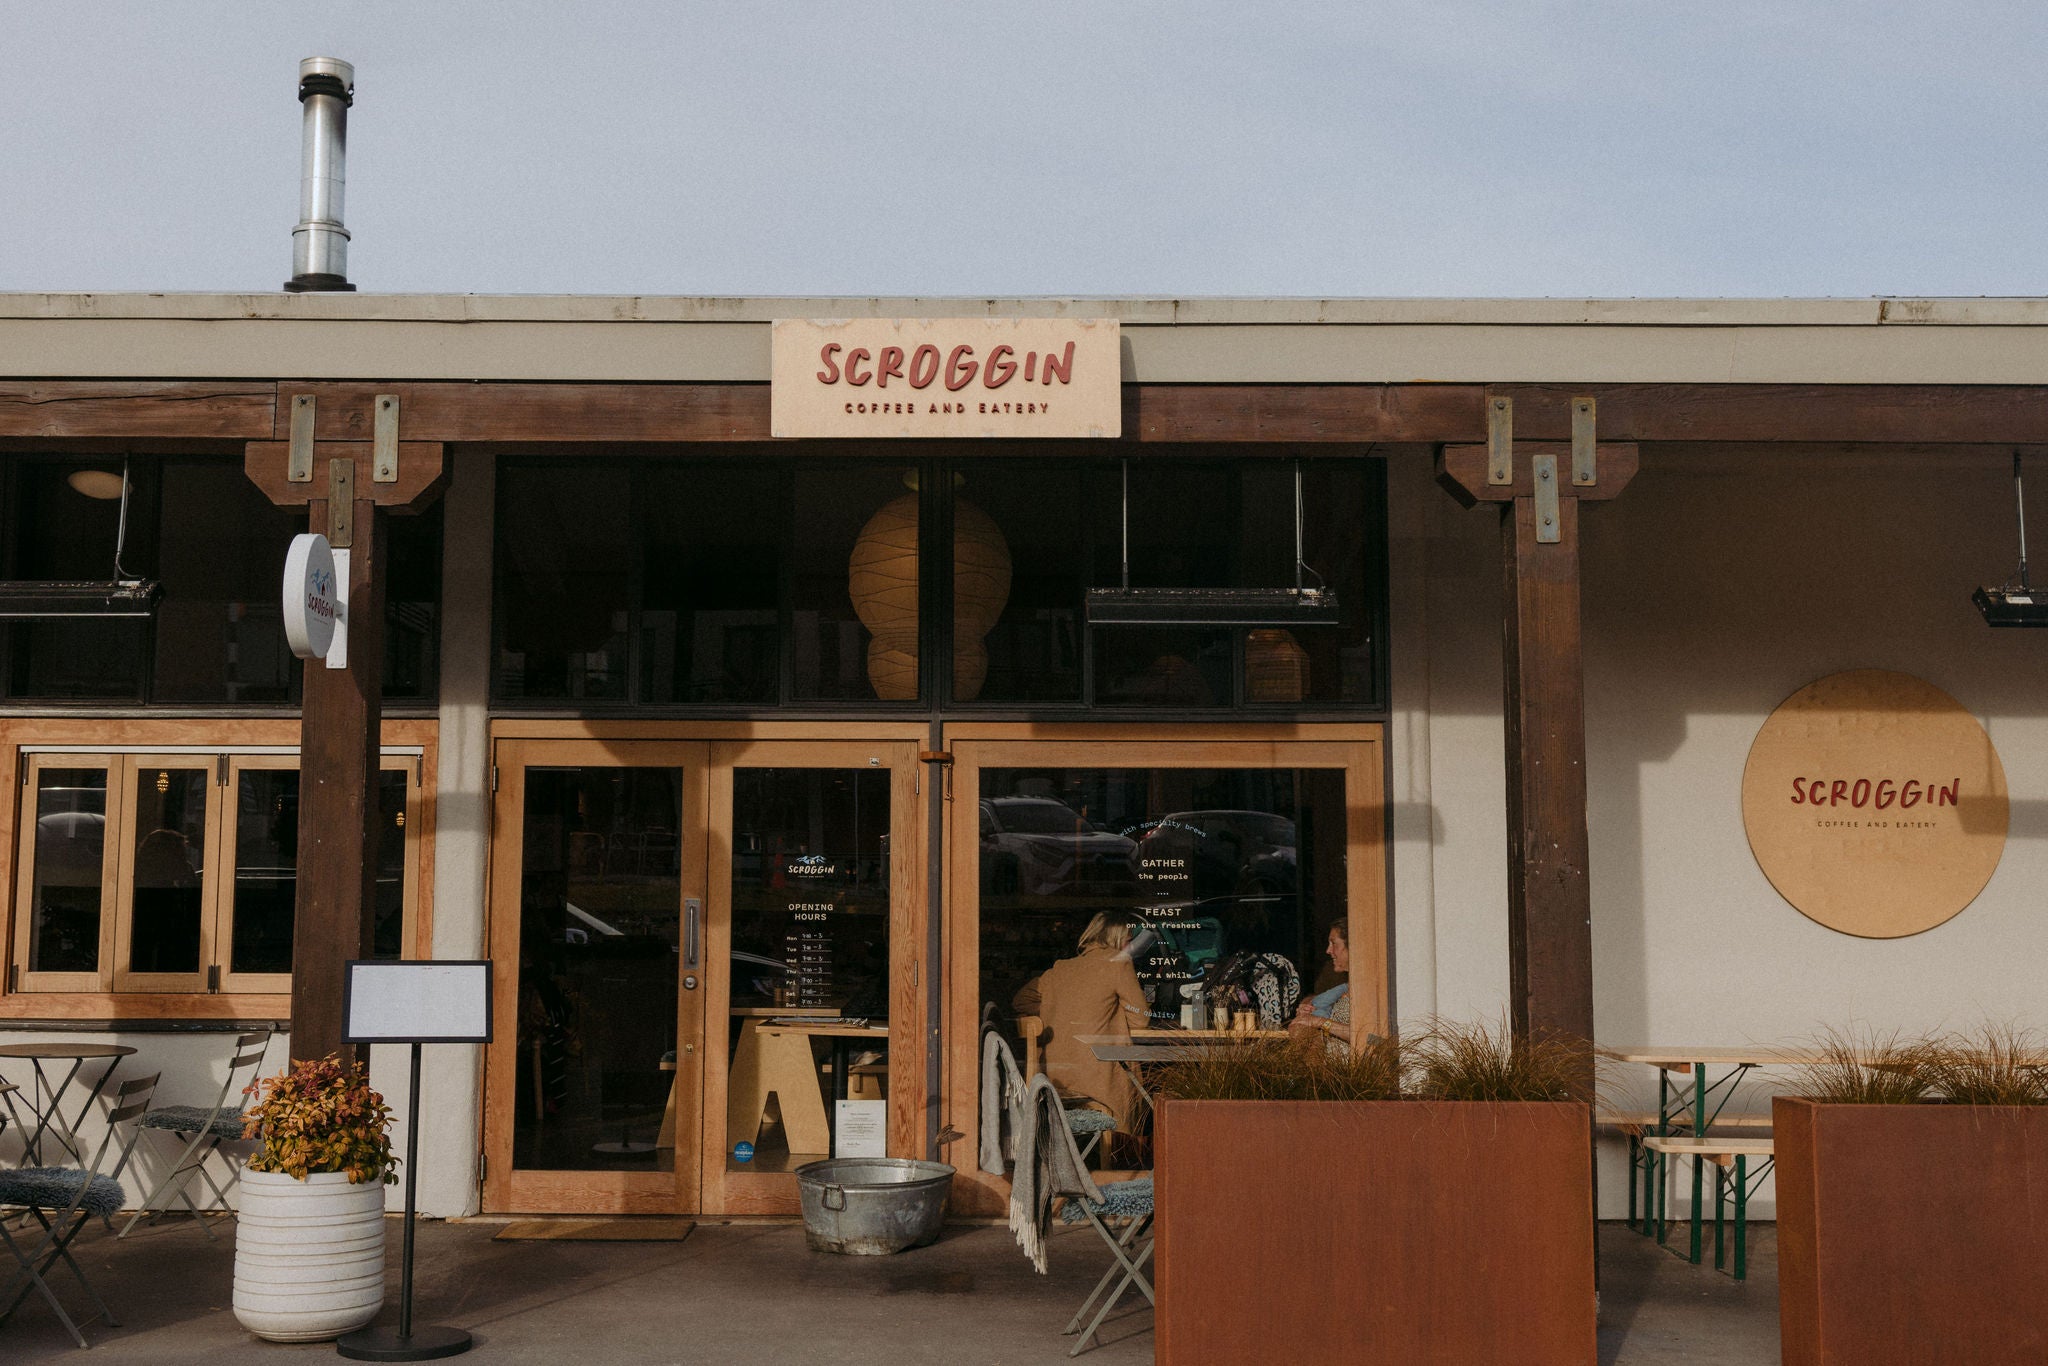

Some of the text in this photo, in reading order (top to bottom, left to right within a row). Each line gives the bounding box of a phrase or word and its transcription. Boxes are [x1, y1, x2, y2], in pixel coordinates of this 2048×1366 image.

[816, 341, 1075, 391] SCROGGIN
[845, 403, 1049, 414] COFFEE AND EATERY
[1790, 777, 1961, 810] SCROGGIN
[1119, 819, 1207, 838] with specialty brews
[1817, 820, 1859, 828] COFFEE
[1896, 821, 1937, 829] EATERY
[1141, 859, 1184, 867] GATHER
[788, 865, 835, 874] SCROGGIN
[1158, 873, 1188, 881] people
[788, 903, 833, 911] OPENING
[1145, 908, 1181, 916] FEAST
[794, 913, 827, 921] HOURS
[1149, 957, 1178, 965] STAY
[1143, 1010, 1176, 1019] quality
